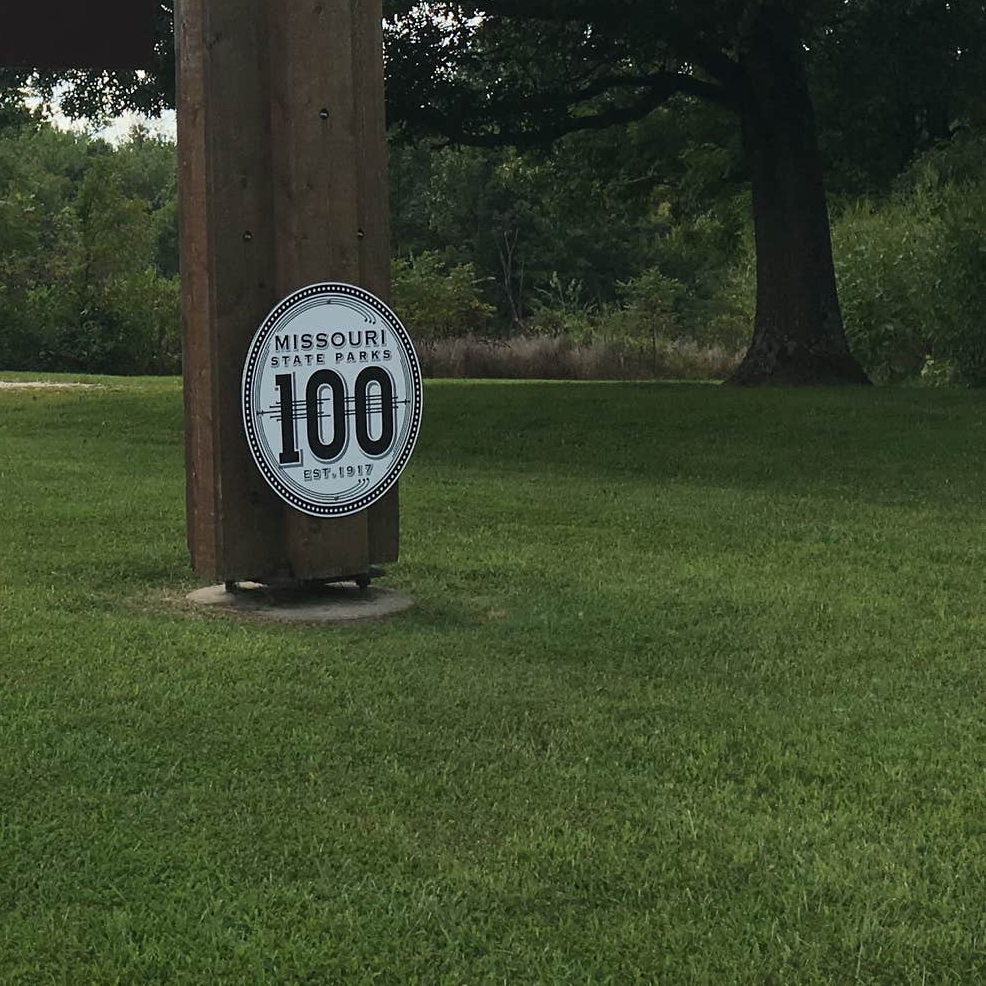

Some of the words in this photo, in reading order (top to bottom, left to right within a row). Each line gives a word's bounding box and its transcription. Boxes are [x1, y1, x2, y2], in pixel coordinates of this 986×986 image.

[274, 329, 387, 352] MISSOURI
[270, 353, 326, 367] STATE
[335, 349, 393, 364] PARKS
[274, 365, 396, 466] 100
